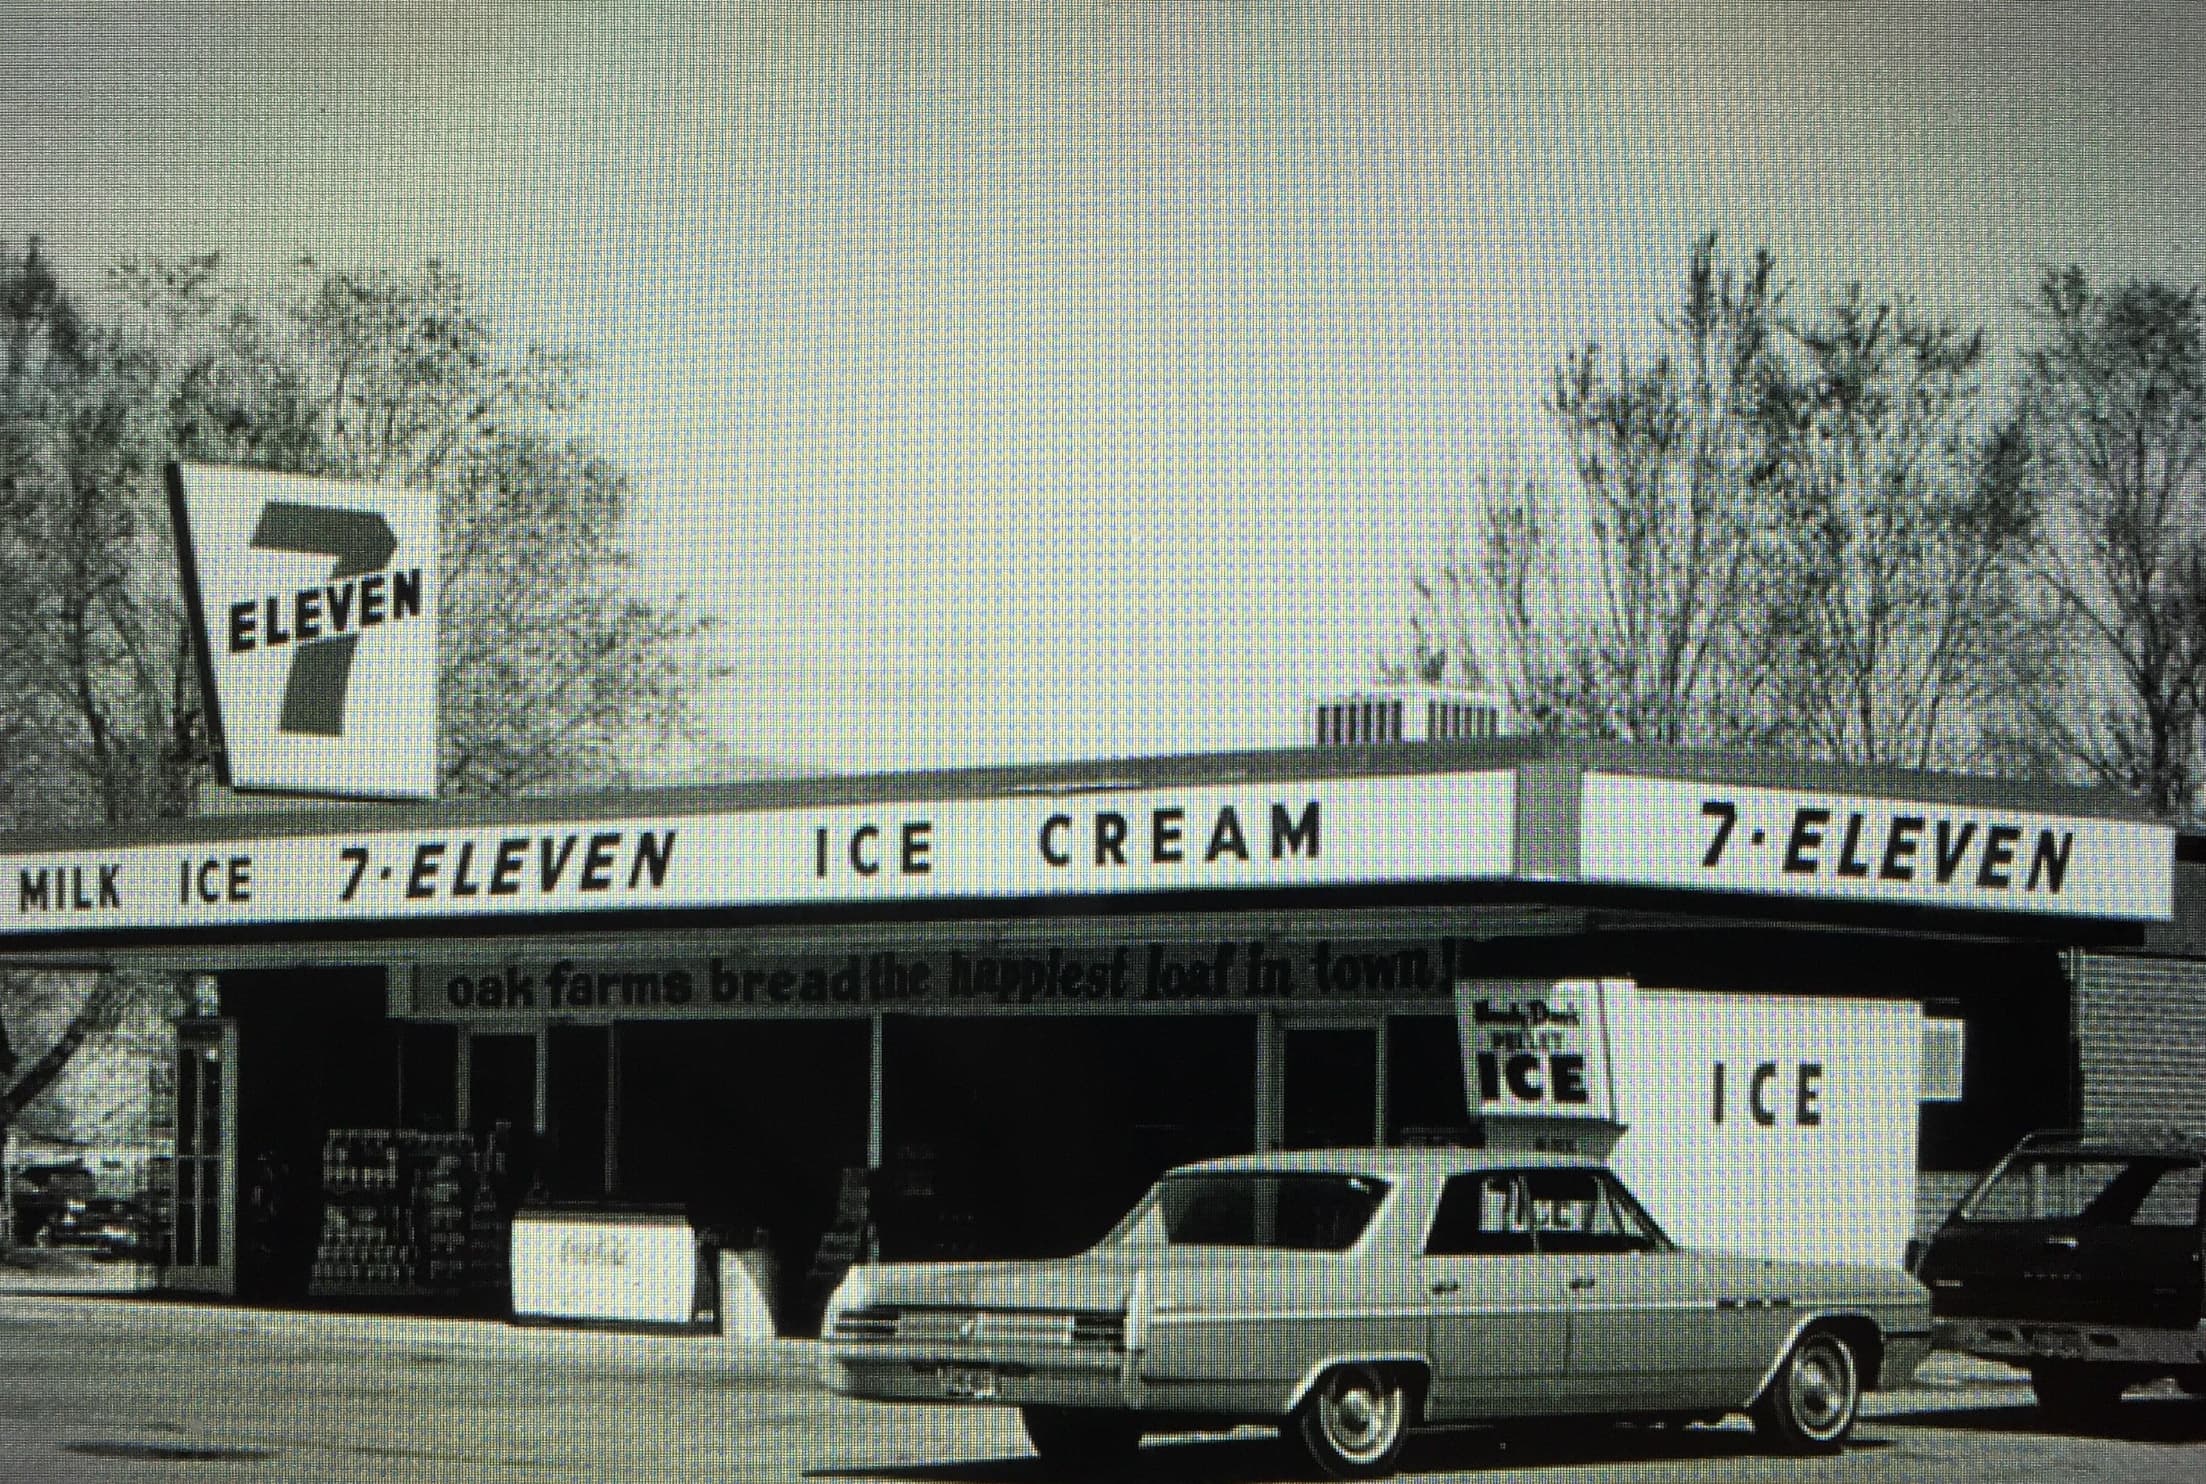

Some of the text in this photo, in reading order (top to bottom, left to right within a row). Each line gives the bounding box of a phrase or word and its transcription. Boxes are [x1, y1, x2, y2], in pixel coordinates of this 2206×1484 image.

[231, 569, 420, 652] ELEVEN
[248, 500, 397, 736] 7
[816, 801, 1320, 878] ICE CREAM
[19, 857, 252, 912] MILK ICE
[446, 966, 534, 1008] oak
[546, 960, 692, 1007] farms
[711, 956, 861, 1004] bread
[869, 951, 931, 1000] the
[1142, 942, 1237, 999] loaf
[1247, 941, 1291, 997] in
[1477, 1053, 1588, 1103] ICE
[1712, 1061, 1823, 1126] ICE
